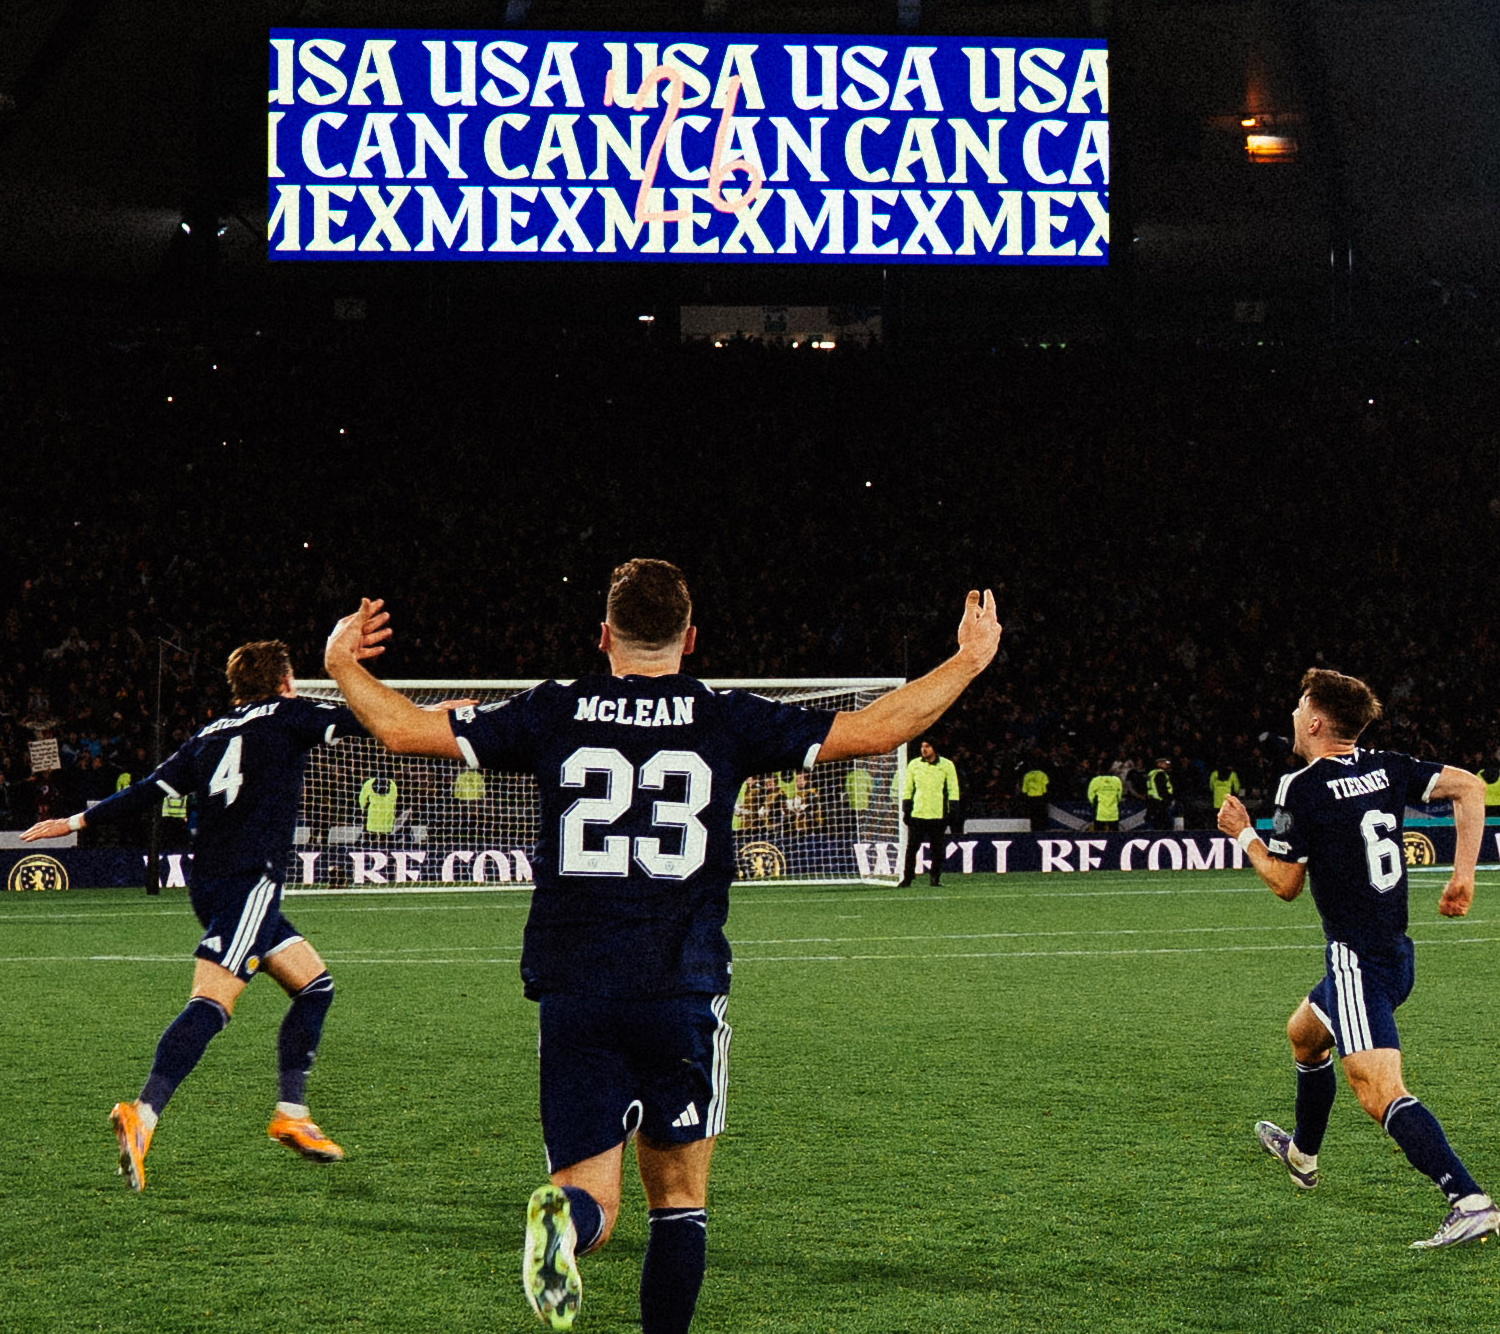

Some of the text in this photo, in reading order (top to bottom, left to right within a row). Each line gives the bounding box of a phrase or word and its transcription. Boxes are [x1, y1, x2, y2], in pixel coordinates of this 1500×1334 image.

[422, 40, 585, 107] USA
[603, 42, 766, 111] USA
[784, 44, 944, 111] USA
[301, 112, 468, 179] CAN
[484, 113, 651, 181] CAN
[665, 115, 831, 183] CAN
[844, 117, 1008, 185] CAN
[208, 734, 244, 808] 4
[1326, 768, 1391, 800] TIERNEY
[559, 747, 713, 881] 23
[1360, 809, 1403, 894] 6
